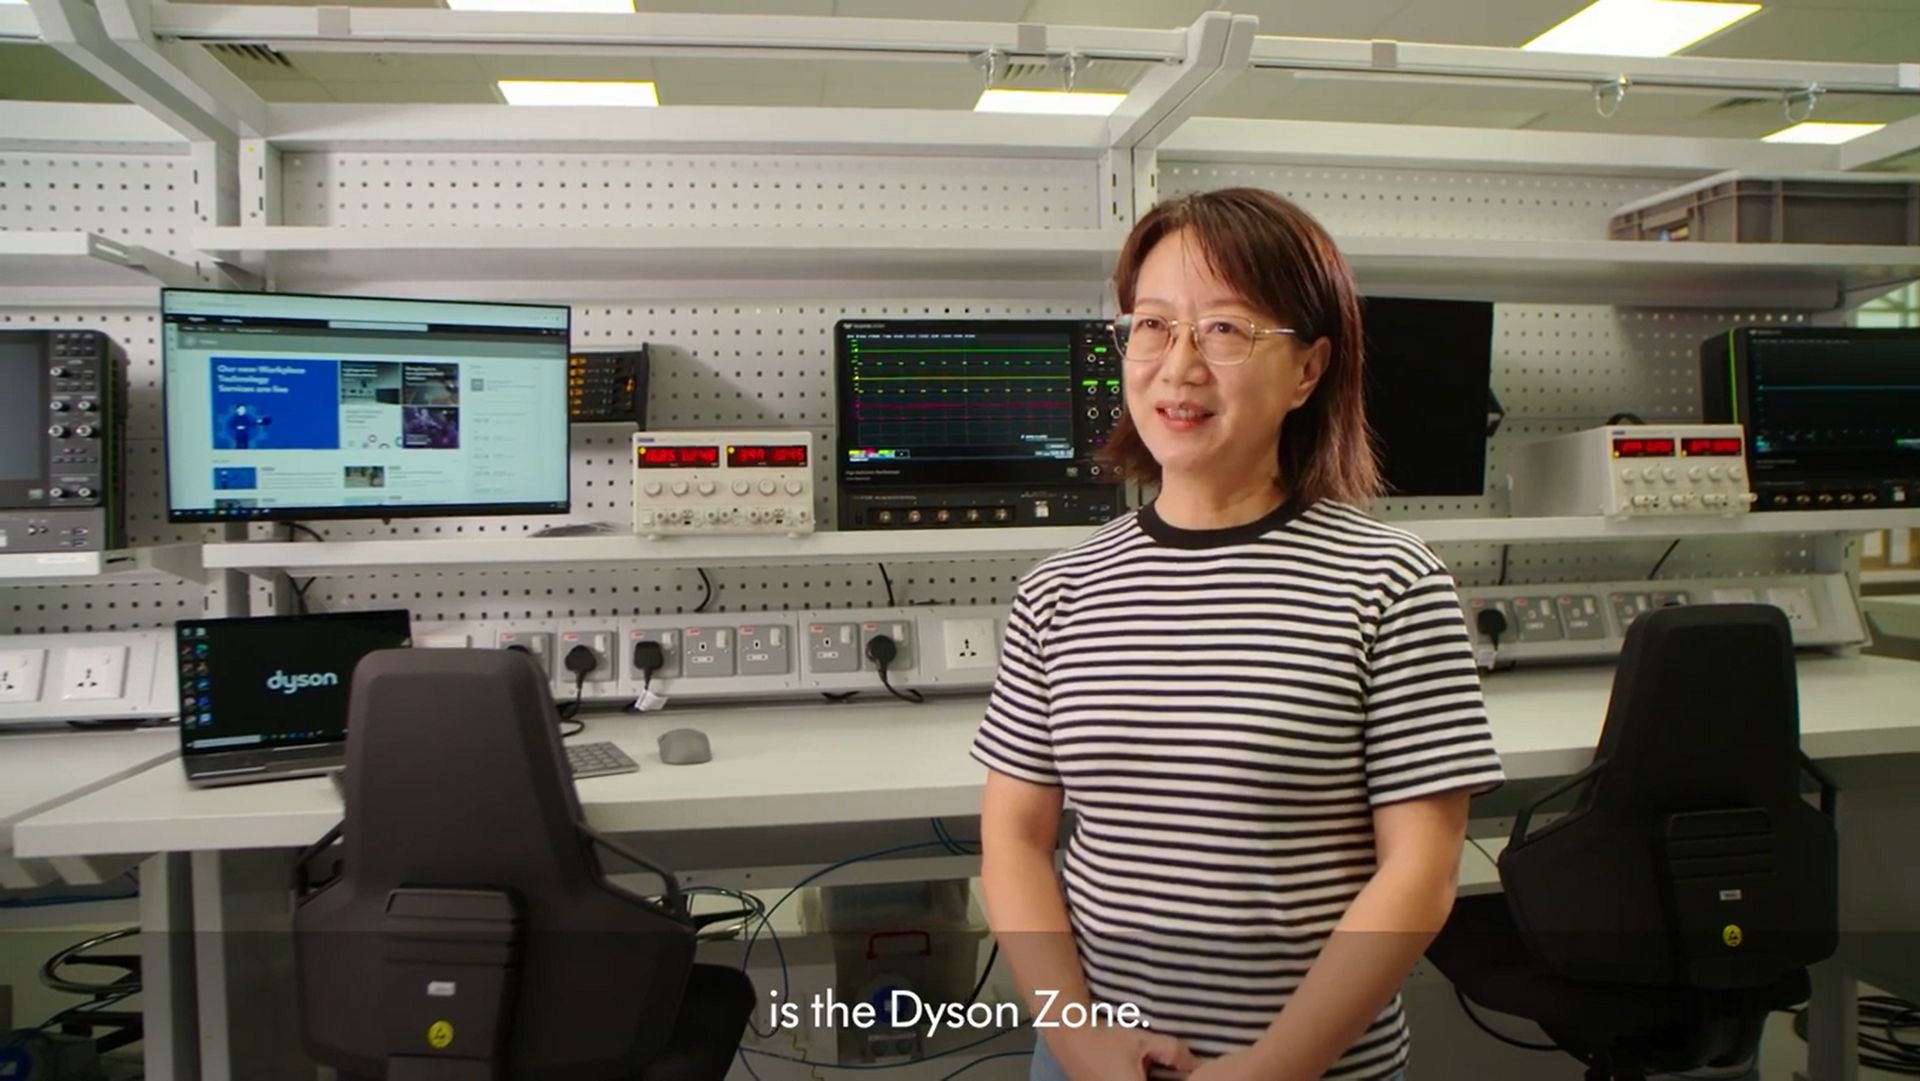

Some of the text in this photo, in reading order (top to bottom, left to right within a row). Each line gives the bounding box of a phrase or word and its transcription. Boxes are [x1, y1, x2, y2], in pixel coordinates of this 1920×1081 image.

[217, 364, 236, 373] Our
[257, 365, 307, 375] Workplace
[217, 374, 270, 385] Technology
[217, 384, 254, 393] Services
[266, 669, 338, 694] dyson
